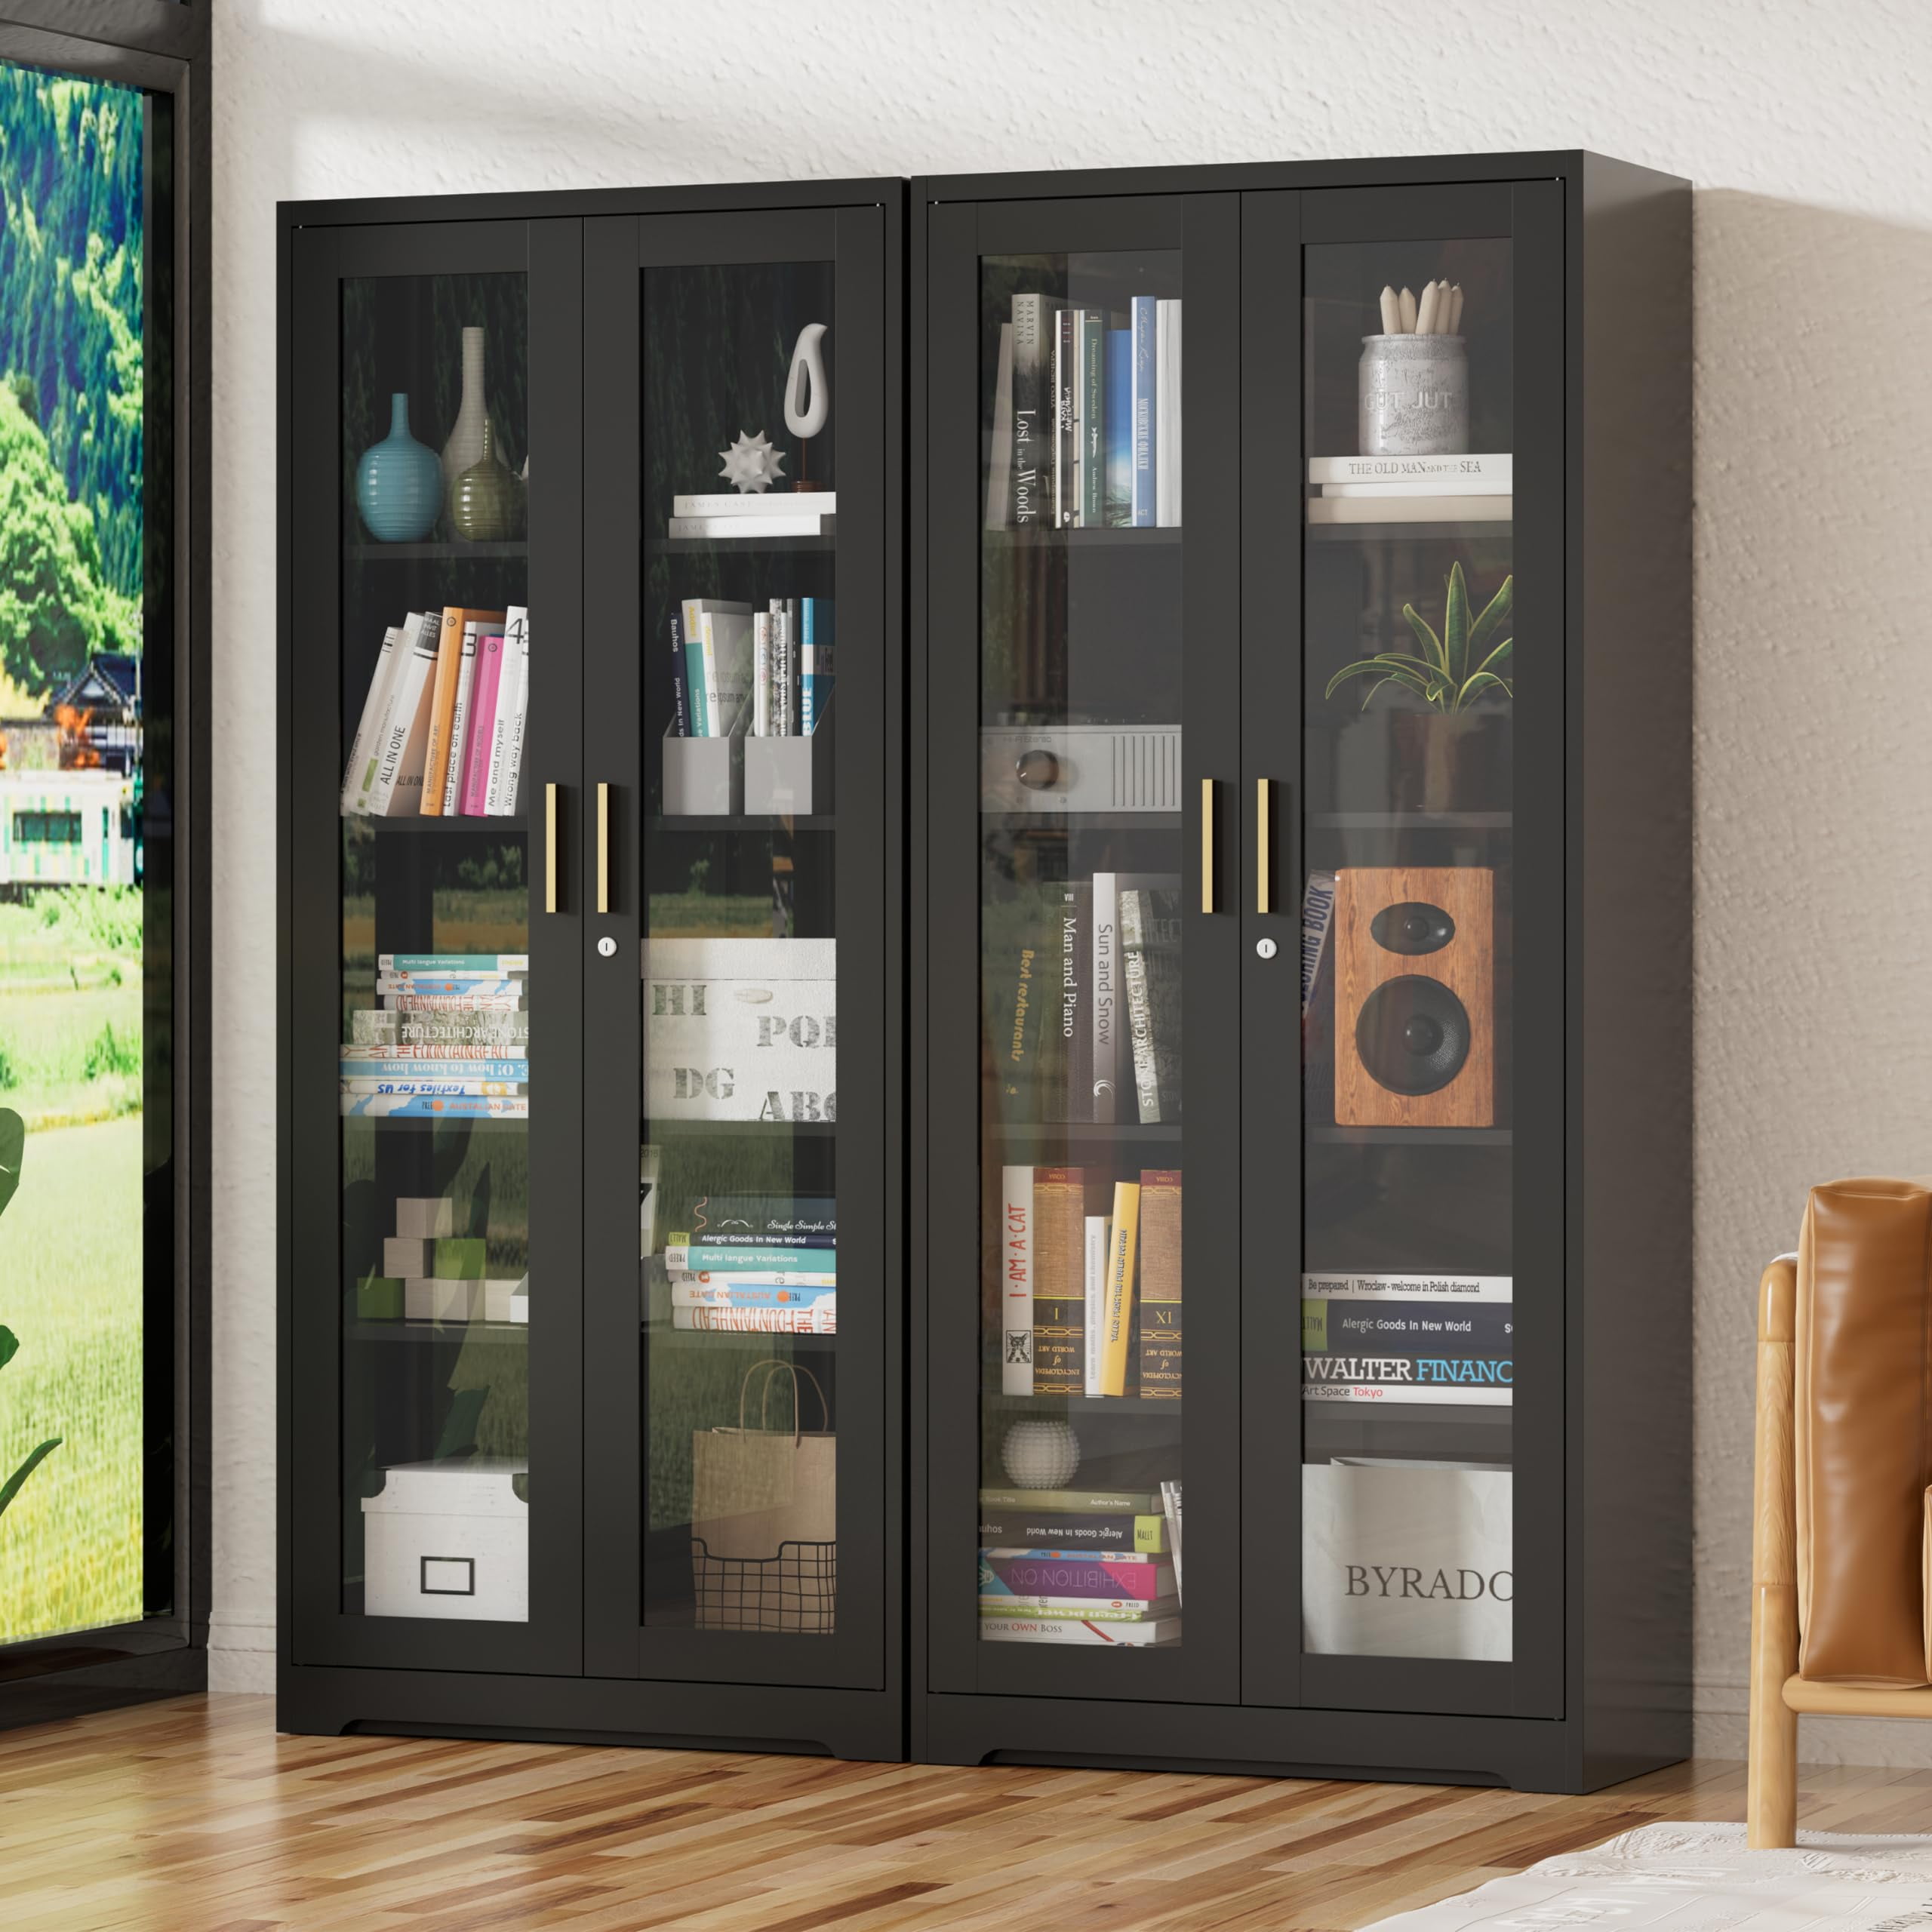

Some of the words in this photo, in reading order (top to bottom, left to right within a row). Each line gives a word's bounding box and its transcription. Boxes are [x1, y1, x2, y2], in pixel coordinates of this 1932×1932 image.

[1017, 409, 1036, 445] Lost
[1349, 463, 1372, 474] THE
[1375, 463, 1398, 474] OLD
[1401, 462, 1426, 474] MAN
[1460, 460, 1481, 473] SEA
[1017, 469, 1036, 523] Woods
[454, 702, 463, 731] earth
[801, 688, 813, 737] BLUE
[512, 712, 522, 742] back
[391, 725, 406, 750] ONE
[451, 734, 459, 748] on
[386, 749, 398, 764] IN
[488, 788, 496, 807] Me
[494, 719, 505, 757] myself
[510, 746, 521, 768] way
[380, 764, 394, 785] ALL
[427, 746, 436, 794] MANUFACTURE
[448, 752, 457, 783] place
[444, 786, 452, 807] Last
[503, 772, 518, 807] Wrong
[1303, 884, 1334, 932] BOOK
[1063, 917, 1076, 953] Man
[1097, 923, 1112, 955] Sun
[1020, 949, 1035, 979] Best
[1063, 958, 1077, 987] and
[1098, 961, 1114, 992] and
[652, 984, 707, 1016] HI
[1063, 992, 1076, 1038] Piano
[1097, 998, 1113, 1045] Snow
[401, 1026, 491, 1038] ARCHITECTURE
[491, 1026, 528, 1038] STONE
[381, 1063, 409, 1075] how
[413, 1063, 448, 1075] know
[451, 1064, 465, 1075] to
[469, 1063, 494, 1075] how
[377, 1084, 394, 1094] US
[397, 1084, 417, 1094] for
[420, 1084, 466, 1095] Textiles
[673, 1067, 735, 1100] DG
[768, 1220, 794, 1232] Single
[795, 1220, 825, 1232] Simple
[1008, 1203, 1026, 1234] CAT
[702, 1235, 728, 1244] Alergic
[725, 1255, 753, 1264] langue
[1009, 1260, 1027, 1282] AM
[1308, 1278, 1318, 1290] Be
[1318, 1279, 1349, 1292] prepared
[1392, 1280, 1421, 1292] welcome
[1423, 1281, 1429, 1292] in
[1429, 1281, 1449, 1293] Polish
[1451, 1282, 1480, 1293] diamond
[692, 1307, 794, 1333] FOUNTAINHEAD
[1155, 1311, 1172, 1324] IX
[1343, 1318, 1374, 1334] Alergic
[1377, 1319, 1406, 1331] Goods
[1410, 1320, 1418, 1331] In
[1422, 1321, 1442, 1331] New
[1445, 1321, 1472, 1332] World
[1053, 1355, 1062, 1365] of
[1160, 1358, 1169, 1369] of
[1304, 1357, 1413, 1381] WALTER
[1417, 1358, 1512, 1383] FINANC
[1303, 1386, 1319, 1395] Art
[1321, 1386, 1350, 1398] Space
[1353, 1386, 1383, 1399] Tokyo
[1026, 1527, 1046, 1536] World
[1066, 1528, 1072, 1537] In
[1075, 1528, 1097, 1537] Goods
[1099, 1527, 1123, 1539] Alergic
[1011, 1568, 1038, 1584] ON
[1042, 1569, 1136, 1589] EXHIBITION
[1345, 1564, 1512, 1601] BYRADO
[984, 1623, 1009, 1632] YOUR
[1011, 1623, 1037, 1632] OWN
